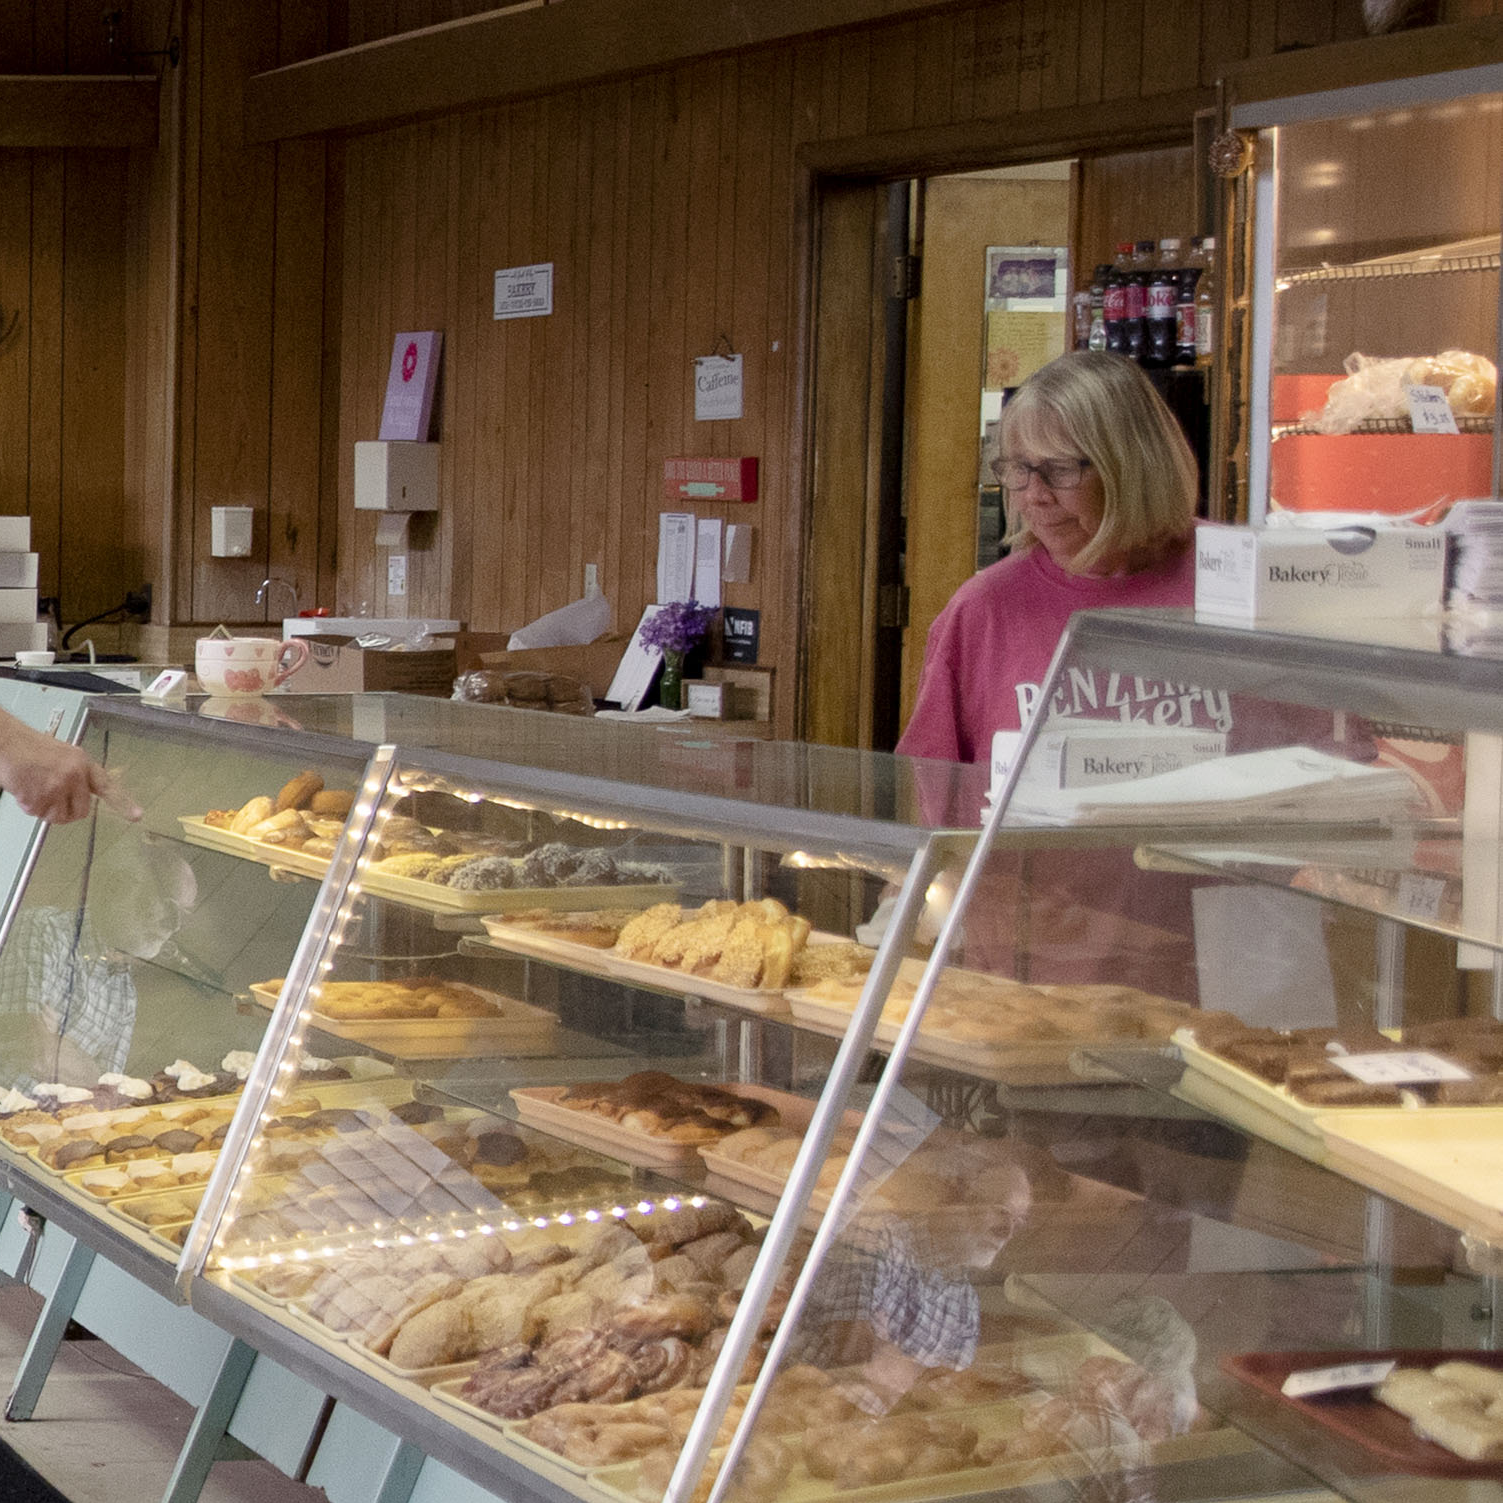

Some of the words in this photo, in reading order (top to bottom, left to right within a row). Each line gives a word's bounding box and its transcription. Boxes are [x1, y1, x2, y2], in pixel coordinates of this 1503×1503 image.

[697, 372, 739, 393] Caffeine
[1405, 537, 1441, 550] Small
[1268, 566, 1330, 587] Bakery
[1118, 688, 1234, 733] kery
[1083, 757, 1144, 778] Bakery
